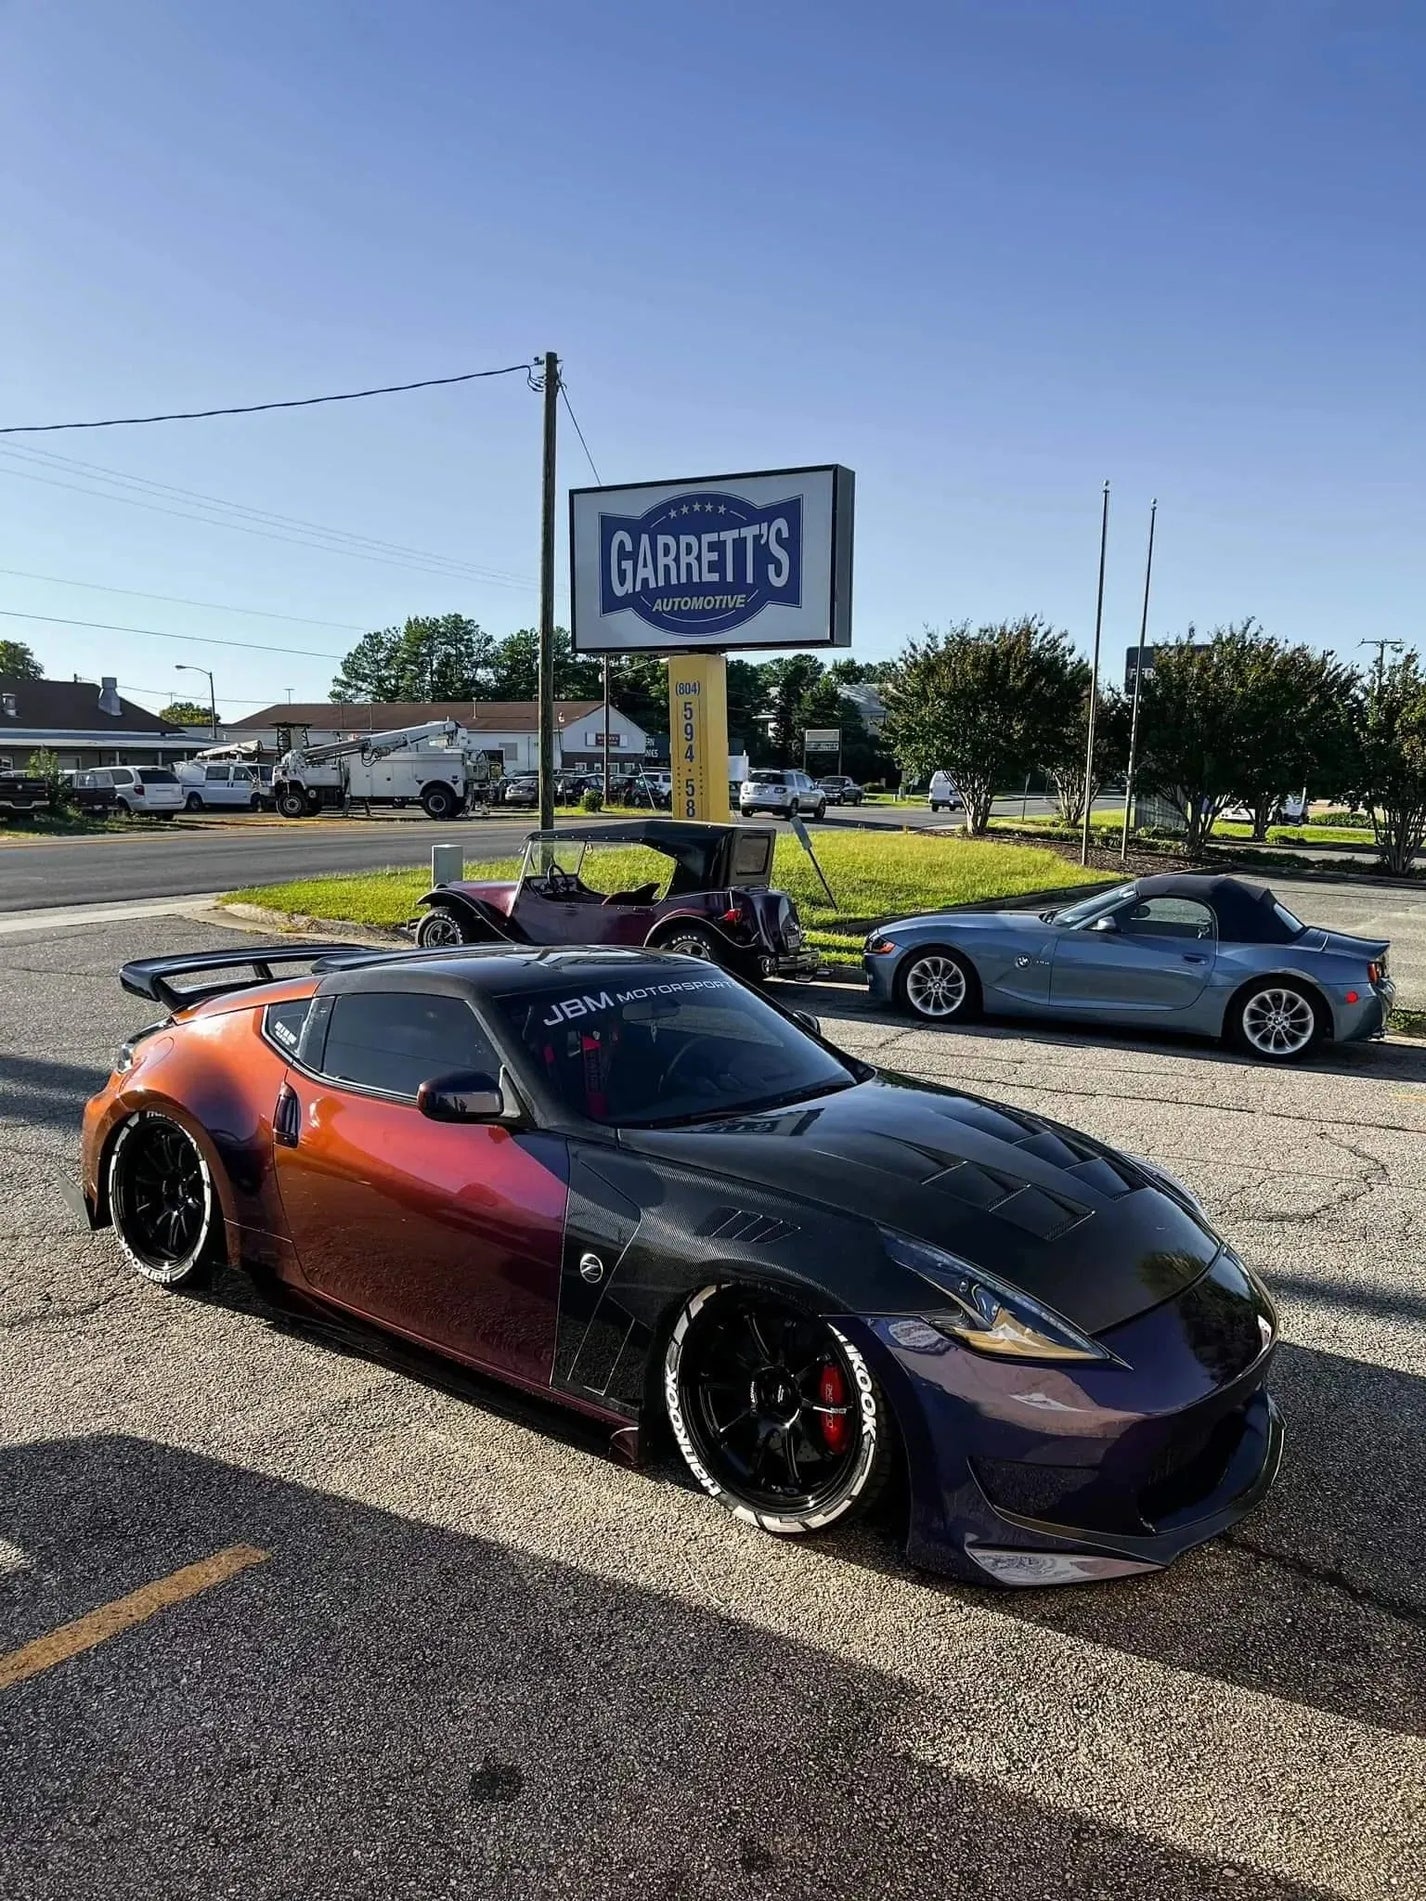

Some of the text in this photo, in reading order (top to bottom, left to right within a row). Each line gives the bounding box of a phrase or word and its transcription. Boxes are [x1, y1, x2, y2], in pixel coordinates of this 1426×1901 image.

[611, 517, 790, 597] GARRETT'S
[652, 594, 747, 612] AUTOMOTIVE
[675, 682, 701, 697] (804)
[543, 991, 615, 1026] JBM
